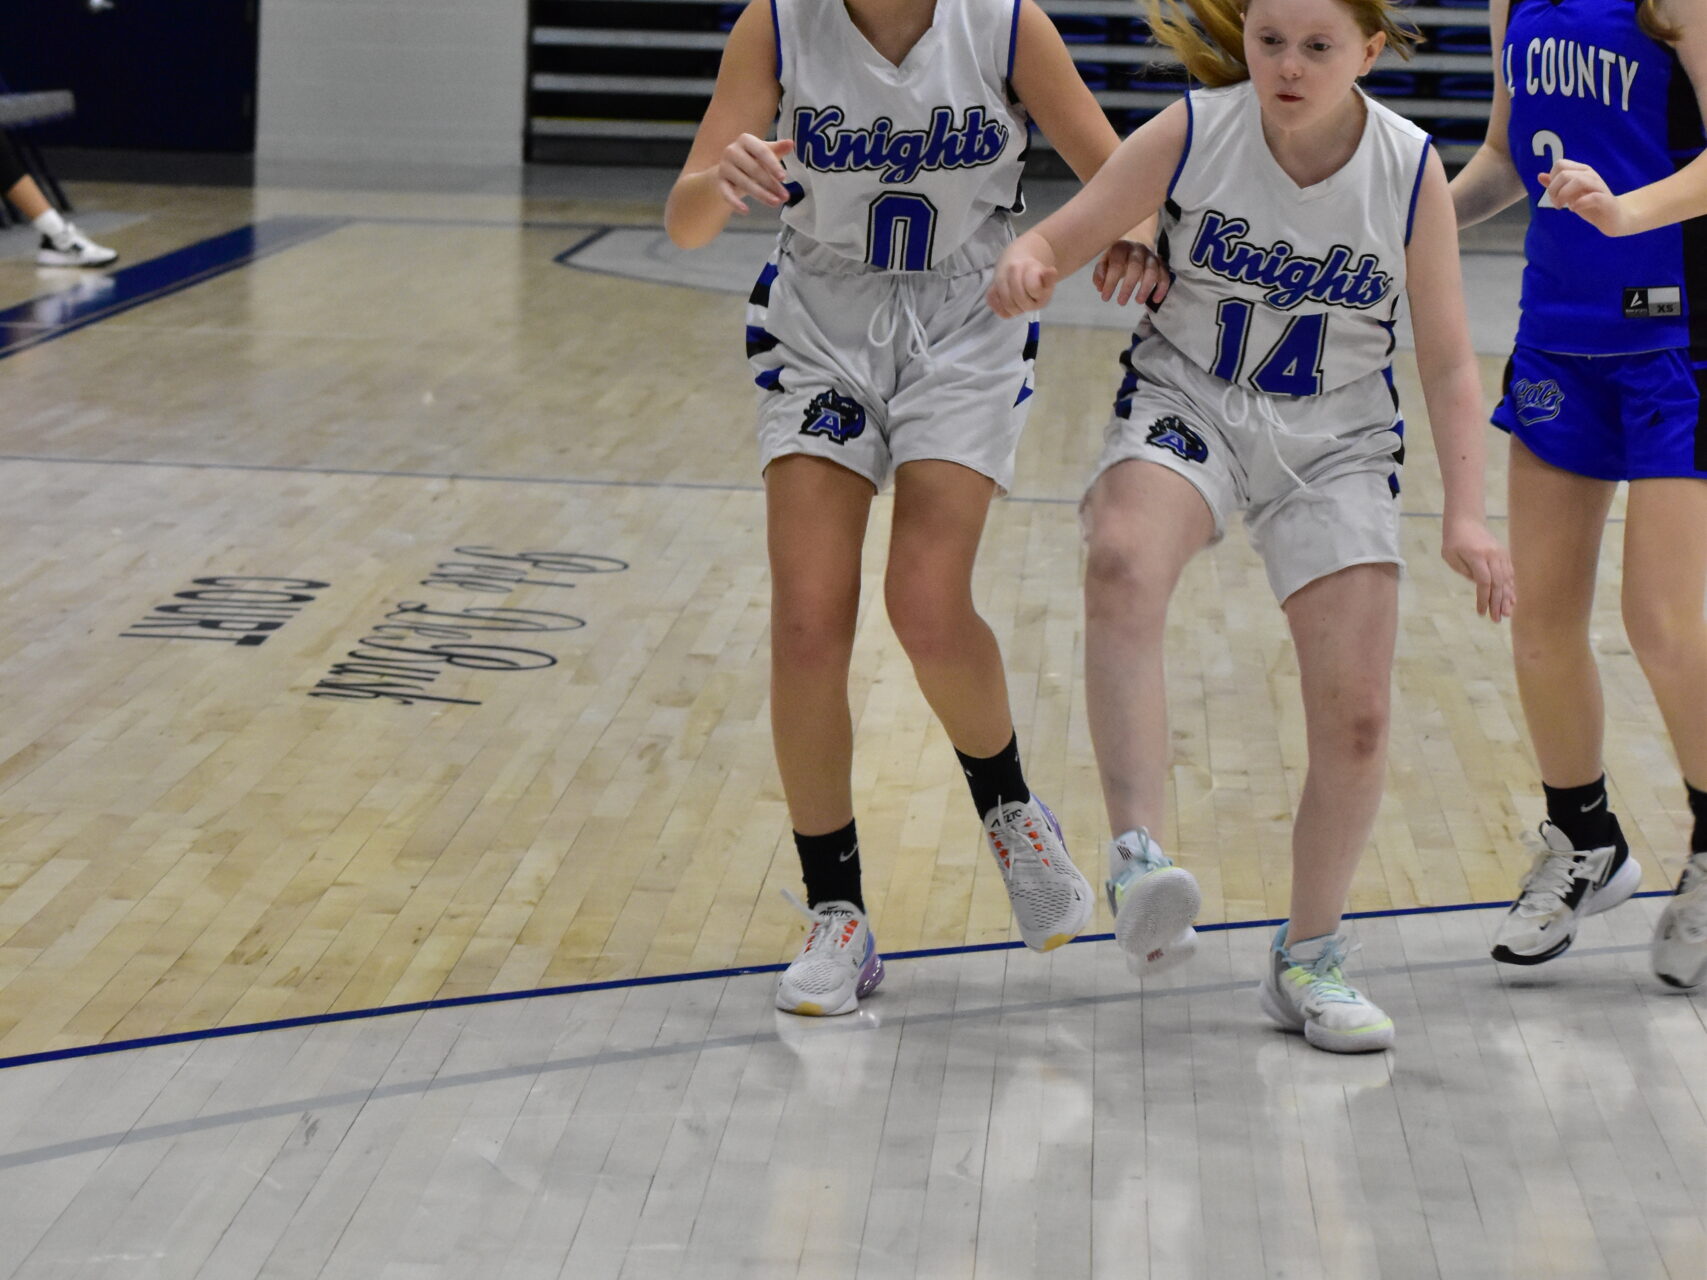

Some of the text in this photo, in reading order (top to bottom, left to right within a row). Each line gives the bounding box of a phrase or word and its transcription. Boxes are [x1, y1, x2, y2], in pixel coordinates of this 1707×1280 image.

[1526, 37, 1640, 112] COUNTY
[793, 105, 1009, 184] Knights
[1531, 129, 1568, 208] 2
[1190, 209, 1394, 311] Knights
[1209, 296, 1328, 398] 14
[804, 406, 843, 442] A
[118, 576, 331, 646] COURT
